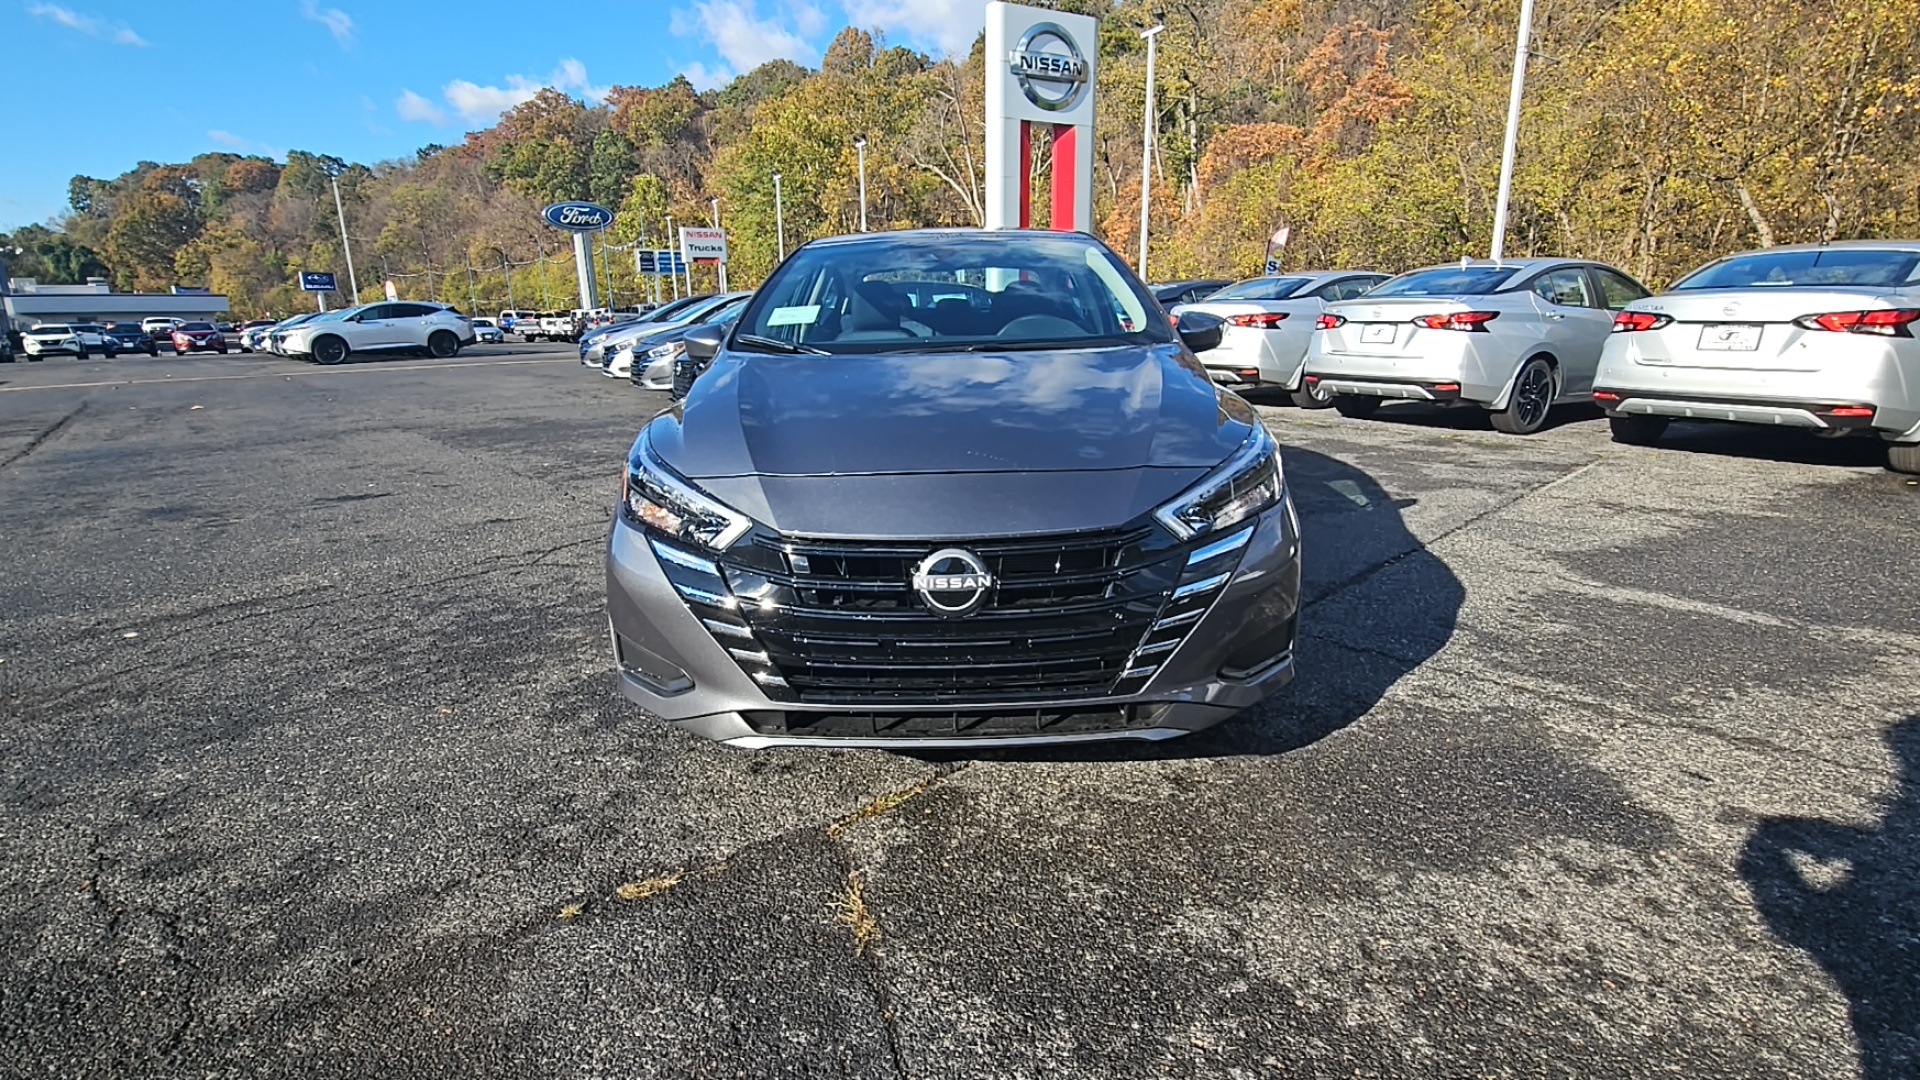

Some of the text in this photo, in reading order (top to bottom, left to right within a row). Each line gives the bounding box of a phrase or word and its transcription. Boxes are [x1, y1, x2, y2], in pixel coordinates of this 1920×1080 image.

[1020, 56, 1083, 76] NISSAN
[560, 207, 601, 224] Ford
[686, 231, 722, 239] NISSAN
[688, 244, 723, 252] Trucks
[915, 576, 991, 589] NISSAN
